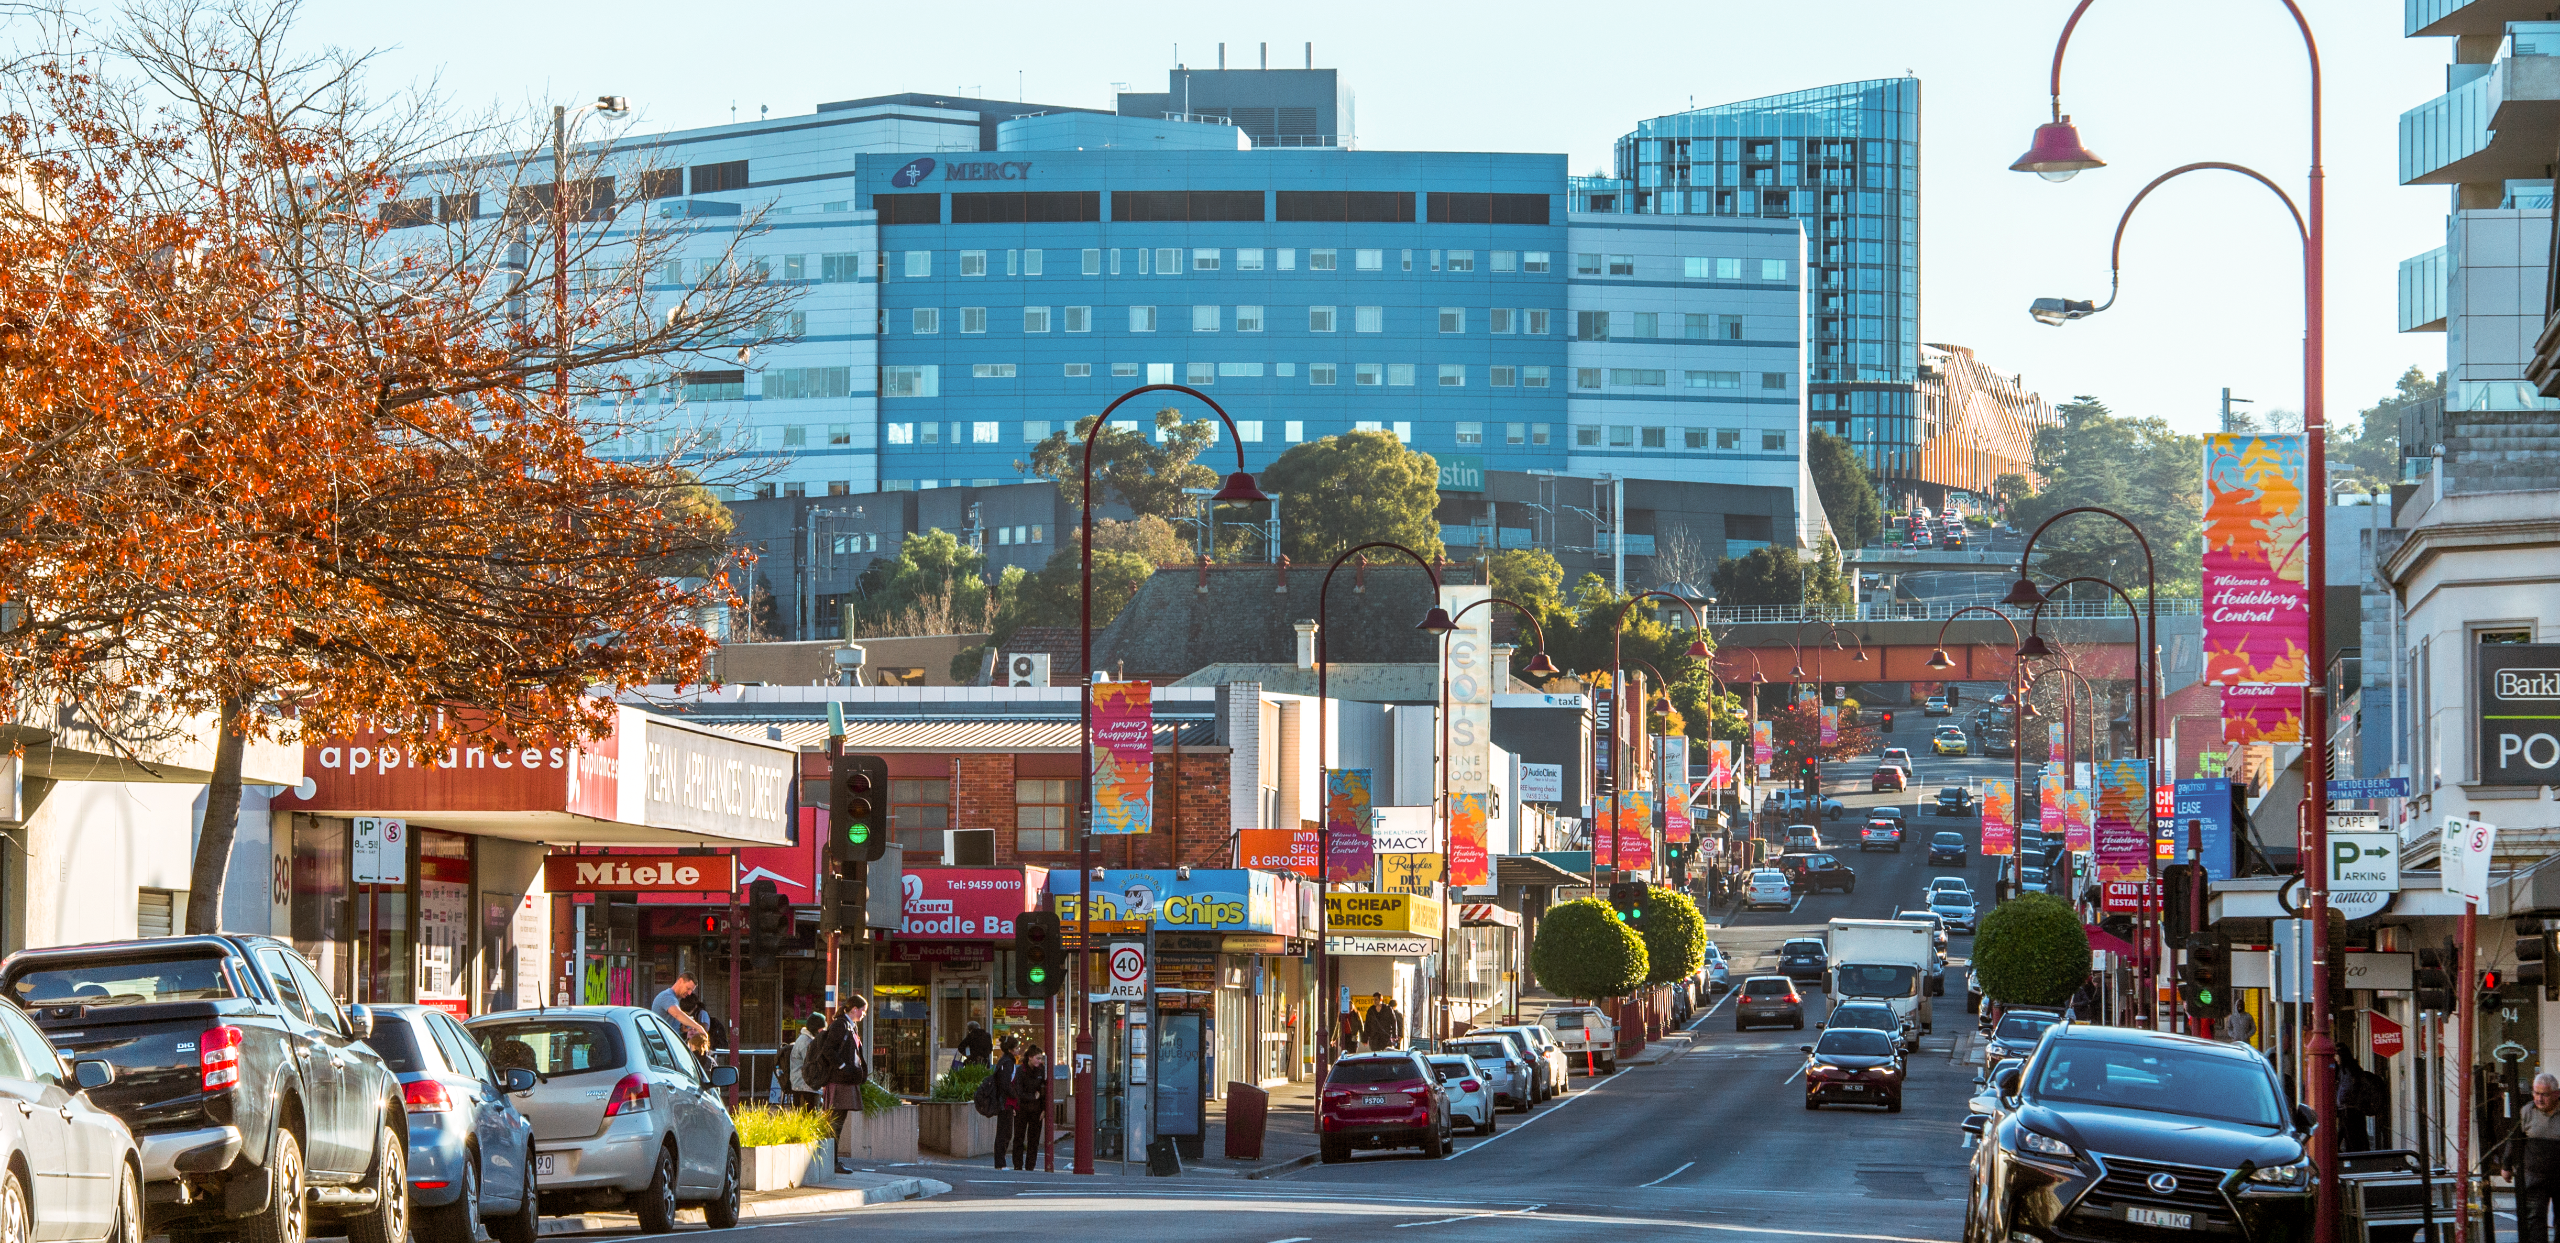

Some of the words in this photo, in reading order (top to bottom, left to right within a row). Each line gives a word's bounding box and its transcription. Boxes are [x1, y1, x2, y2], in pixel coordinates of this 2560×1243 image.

[945, 161, 1032, 180] MERCY
[2213, 575, 2257, 586] Welcome
[2259, 577, 2270, 585] to
[2213, 589, 2297, 610] Heidelberg
[2213, 607, 2275, 622] Central
[2228, 686, 2276, 696] Central
[1558, 695, 1580, 705] taxE
[1111, 721, 1147, 730] Central
[1098, 729, 1148, 742] Heidelberg
[2500, 733, 2560, 770] PO
[319, 746, 564, 775] applances
[1451, 771, 1482, 781] OOD
[644, 742, 677, 804] PEAN
[683, 752, 743, 817] APPLIANCES
[749, 764, 782, 823] DIRECT
[2337, 779, 2391, 789] HEIDELBERG
[2327, 789, 2363, 799] PRIMARY
[2366, 788, 2401, 798] SCHOOL
[2177, 801, 2202, 814] LEASE
[2338, 816, 2365, 827] CAPE
[359, 820, 375, 836] 1P
[1331, 839, 1369, 847] Heidelberg
[2101, 835, 2144, 845] Heidelberg
[1290, 844, 1318, 854] SPIC
[2102, 843, 2132, 852] Central
[1453, 850, 1484, 858] Heidelberg
[1250, 856, 1259, 866] &
[1262, 856, 1319, 866] GROCERI
[575, 861, 700, 885] Miele
[274, 854, 289, 905] 89
[947, 880, 966, 889] Tel:
[968, 881, 995, 889] 9459
[996, 881, 1021, 889] 0019
[1400, 875, 1422, 885] DRY
[2109, 884, 2163, 895] CHINEE
[909, 901, 950, 912] Tsuru
[1347, 899, 1401, 911] CHEAP
[1054, 895, 1117, 921] Fish
[1123, 907, 1157, 924] And
[1163, 894, 1244, 929] Chips
[893, 916, 975, 934] Noodle
[983, 916, 1014, 934] Ba
[1326, 914, 1383, 926] ABRICS
[919, 945, 957, 955] Noodle
[964, 945, 985, 955] Bar
[1343, 936, 1427, 953] PHARMACY
[1115, 957, 1138, 971] 40
[1111, 986, 1142, 996] AREA
[2502, 1007, 2519, 1023] 94
[2374, 1037, 2401, 1045] CENTRE
